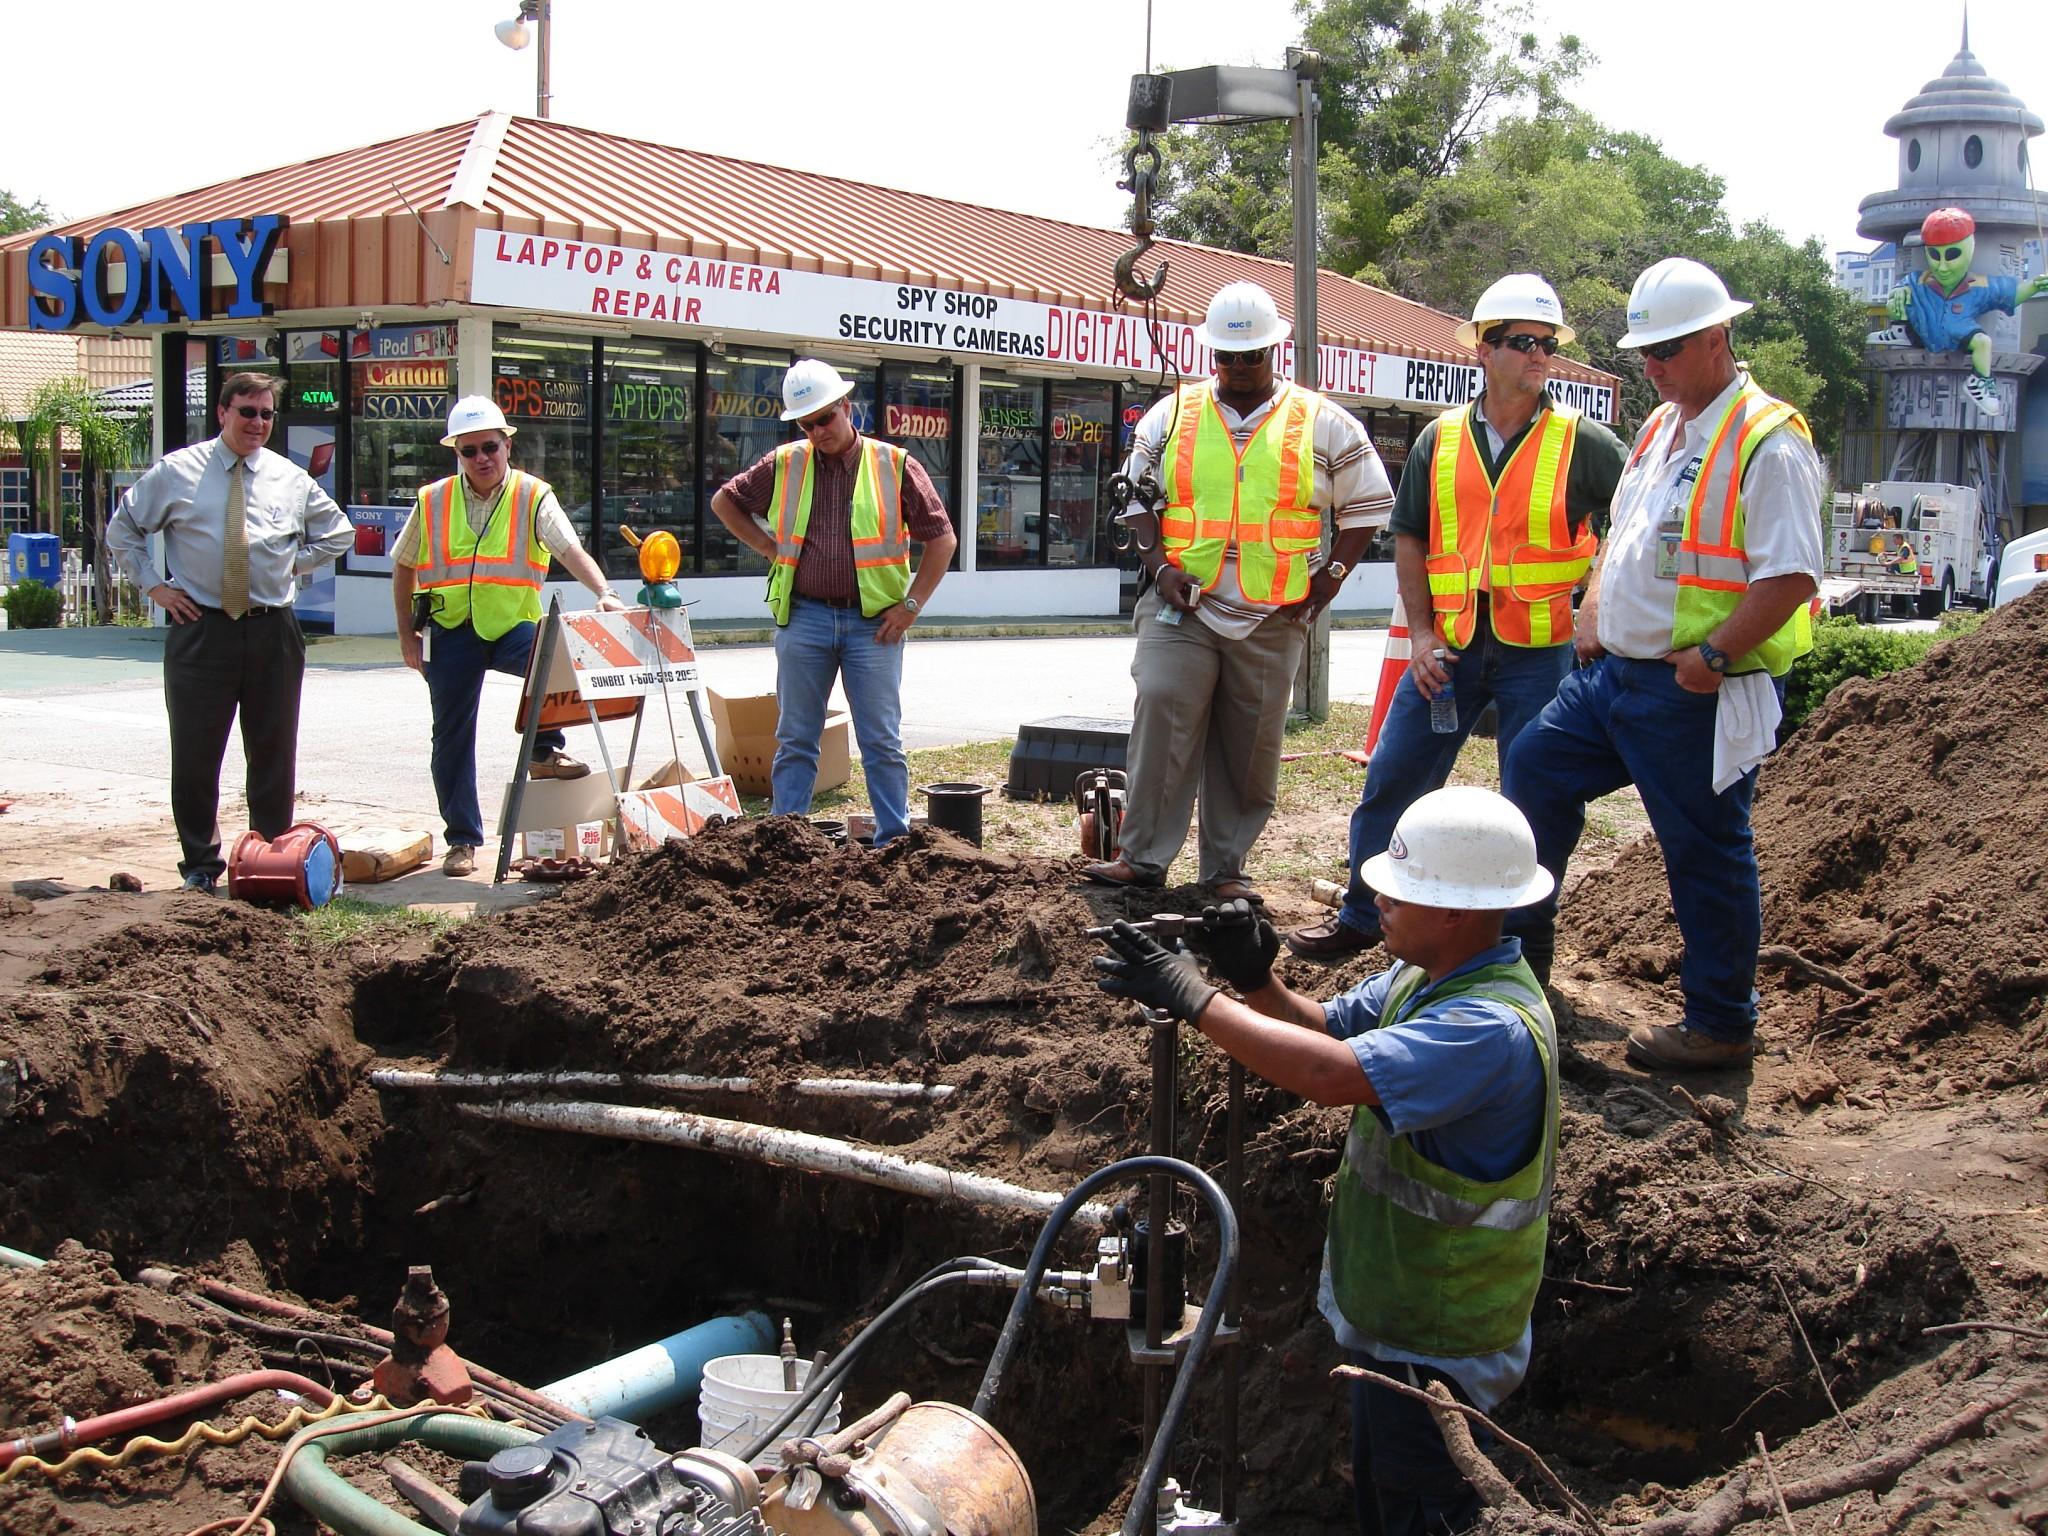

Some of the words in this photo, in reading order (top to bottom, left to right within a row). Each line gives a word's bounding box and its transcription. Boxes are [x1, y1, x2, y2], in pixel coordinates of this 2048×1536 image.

[28, 214, 288, 331] SONY
[496, 234, 624, 276] LAPTOP
[635, 254, 653, 280] &
[665, 258, 781, 295] CAMERA
[591, 287, 702, 324] REPAIR
[897, 286, 938, 313] SPY
[944, 292, 998, 320] SHOP
[380, 337, 408, 356] iPod
[839, 314, 947, 346] SECURITY
[953, 326, 1045, 357] CAMERAS
[1047, 308, 1143, 369] DIGITAL
[367, 364, 449, 387] Canon
[1405, 360, 1478, 407] PERFUME
[1566, 383, 1611, 422] OUTLET
[302, 391, 335, 403] ATM
[367, 394, 445, 420] SONY
[495, 376, 543, 416] GPS
[544, 401, 586, 416] TOMTOM
[886, 405, 948, 438] Canon
[355, 511, 383, 520] SONY
[590, 674, 626, 688] SUNBELT
